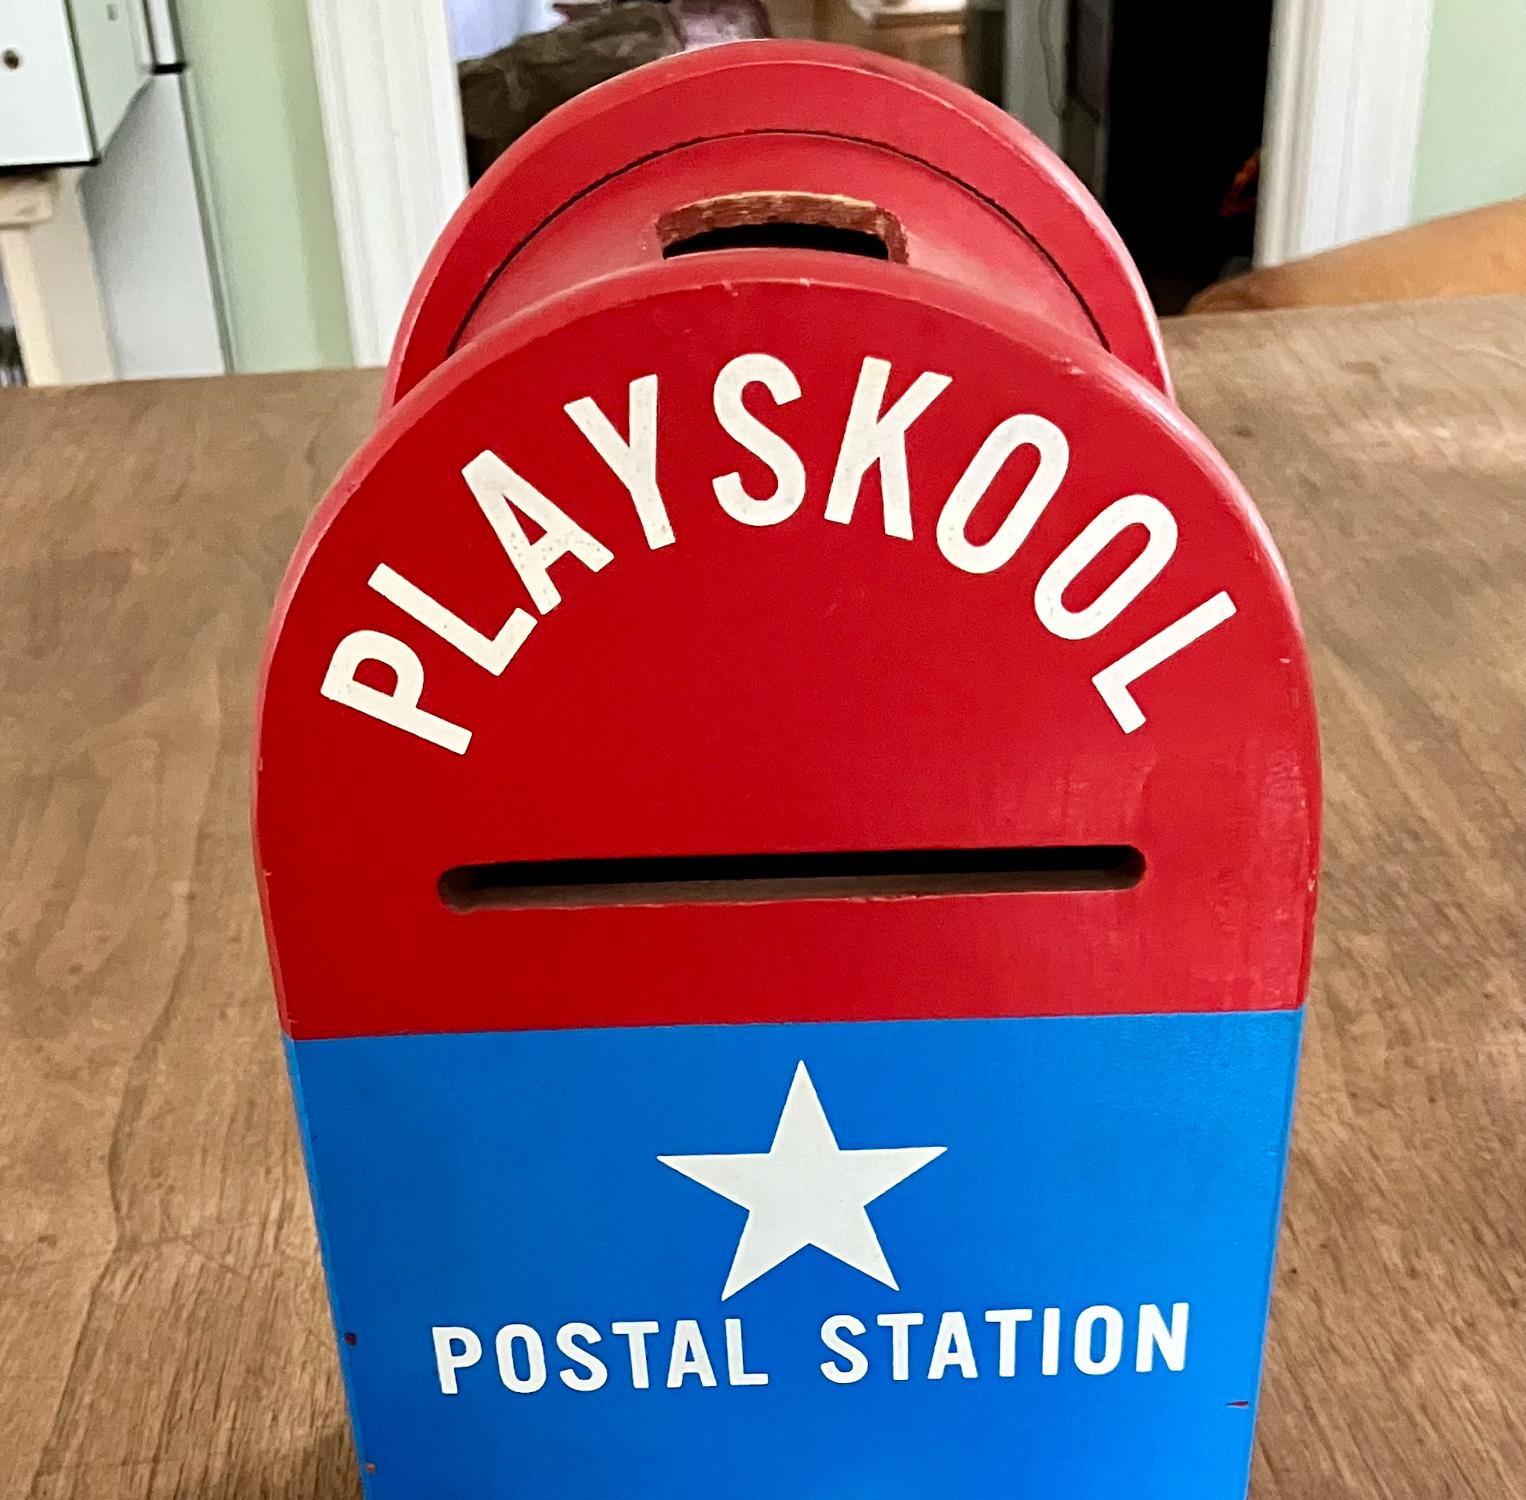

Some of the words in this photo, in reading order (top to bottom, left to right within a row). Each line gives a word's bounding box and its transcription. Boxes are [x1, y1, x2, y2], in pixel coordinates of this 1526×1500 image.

[320, 353, 1238, 755] PLAYSKOOL
[432, 1318, 769, 1394] POSTAL
[820, 1303, 1189, 1384] STATION
